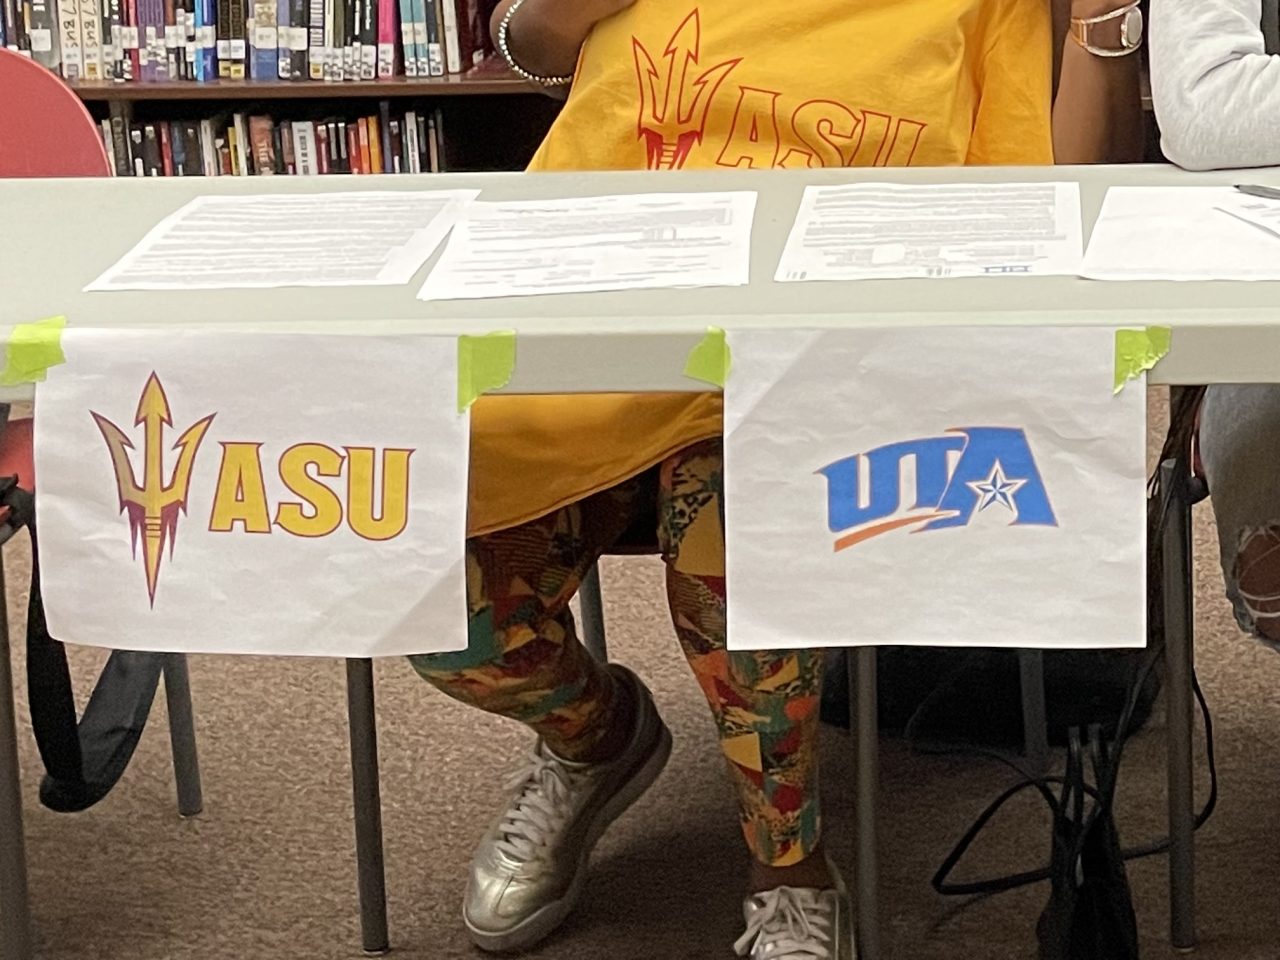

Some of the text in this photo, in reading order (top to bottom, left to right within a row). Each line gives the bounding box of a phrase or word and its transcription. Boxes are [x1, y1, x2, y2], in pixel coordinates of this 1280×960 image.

[63, 20, 77, 48] BUS
[84, 21, 98, 48] BUS
[716, 86, 927, 169] ASU
[209, 441, 416, 541] ASU
[812, 426, 1059, 534] UTA
